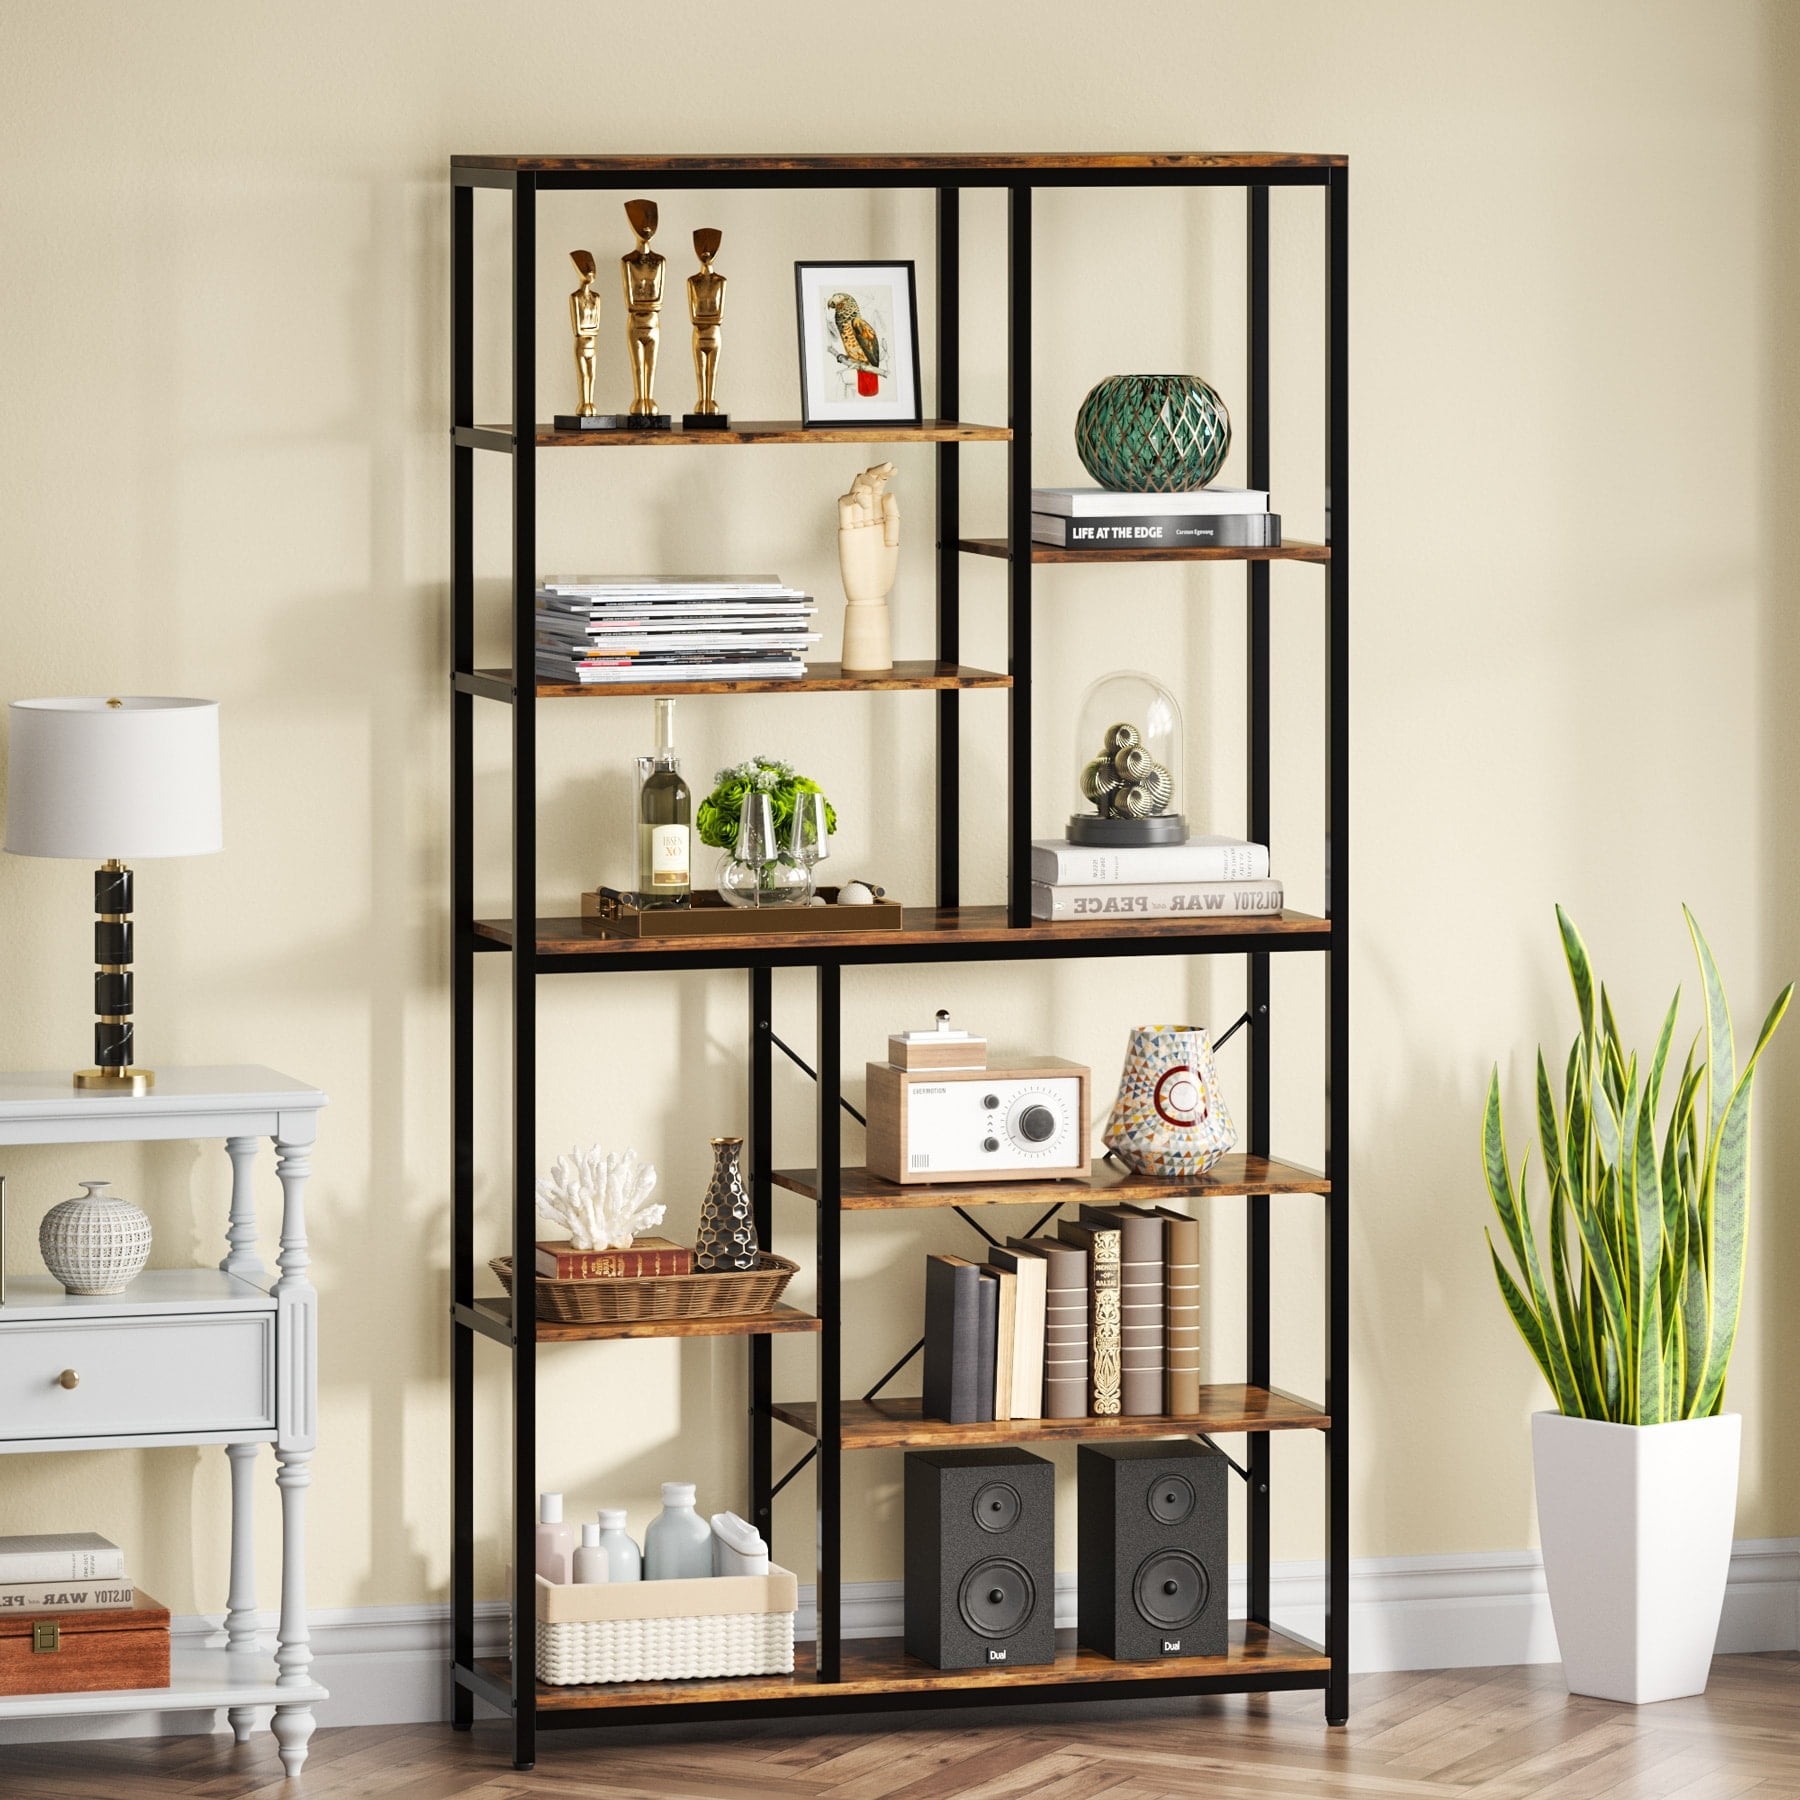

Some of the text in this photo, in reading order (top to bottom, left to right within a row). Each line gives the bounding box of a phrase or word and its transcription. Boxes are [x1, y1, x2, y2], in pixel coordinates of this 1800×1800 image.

[1072, 526, 1163, 539] LIFE AT THE EDGE
[1164, 1640, 1181, 1651] Dual
[989, 1649, 1007, 1660] Dual
